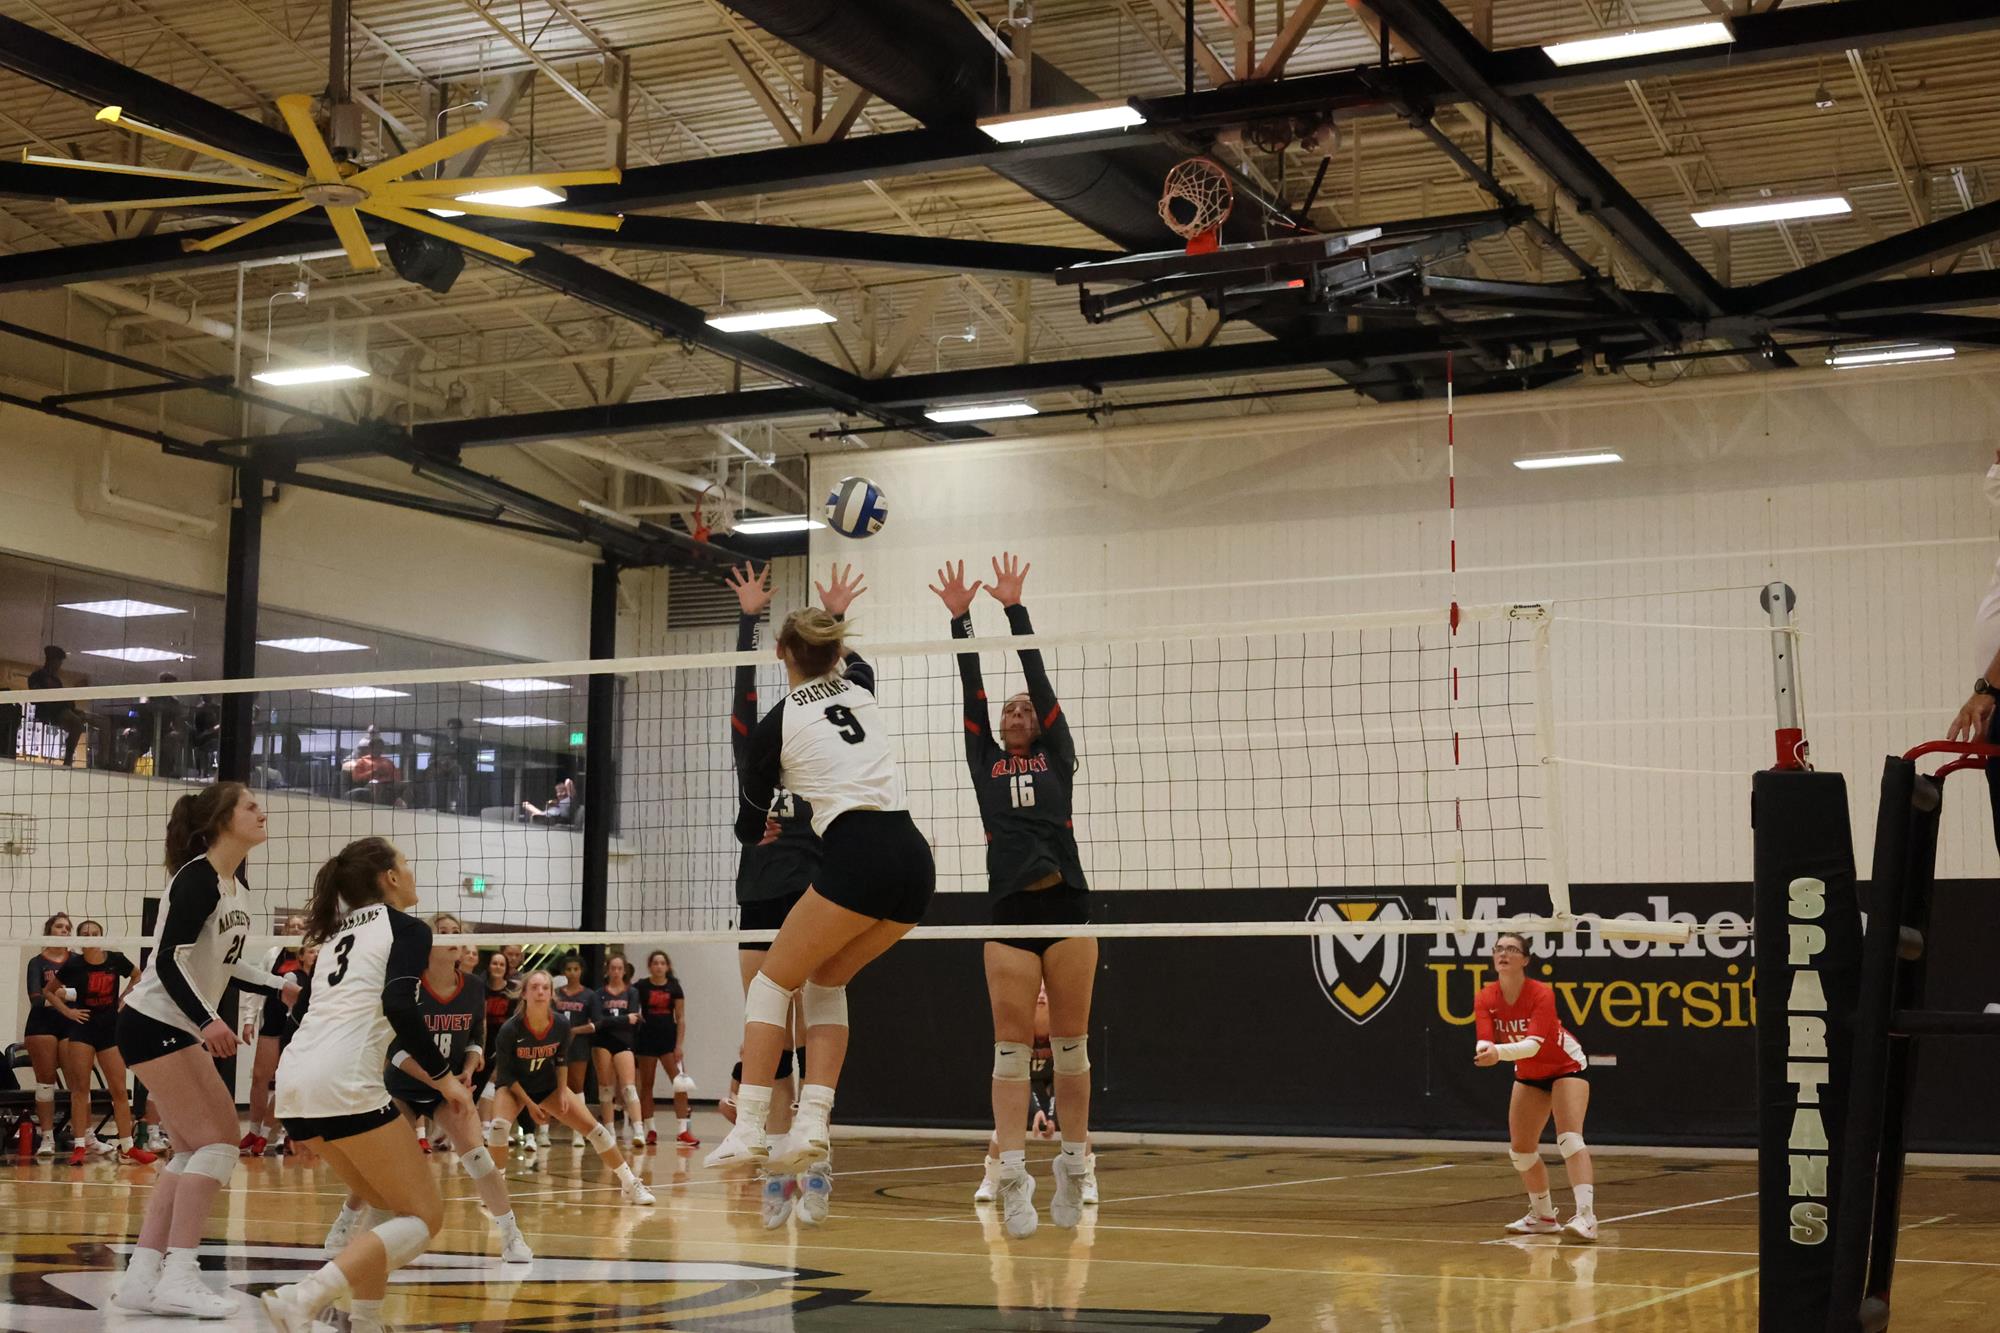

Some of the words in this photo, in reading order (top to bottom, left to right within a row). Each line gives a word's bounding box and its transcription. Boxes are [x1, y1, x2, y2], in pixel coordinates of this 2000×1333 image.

[791, 680, 849, 706] SPARTANS
[824, 704, 866, 745] 9
[767, 787, 795, 818] 23
[1010, 774, 1036, 808] 16
[223, 934, 246, 965] 21
[327, 933, 355, 987] 3
[423, 1013, 473, 1032] LIVET
[1786, 877, 1830, 1245] SPARTANS
